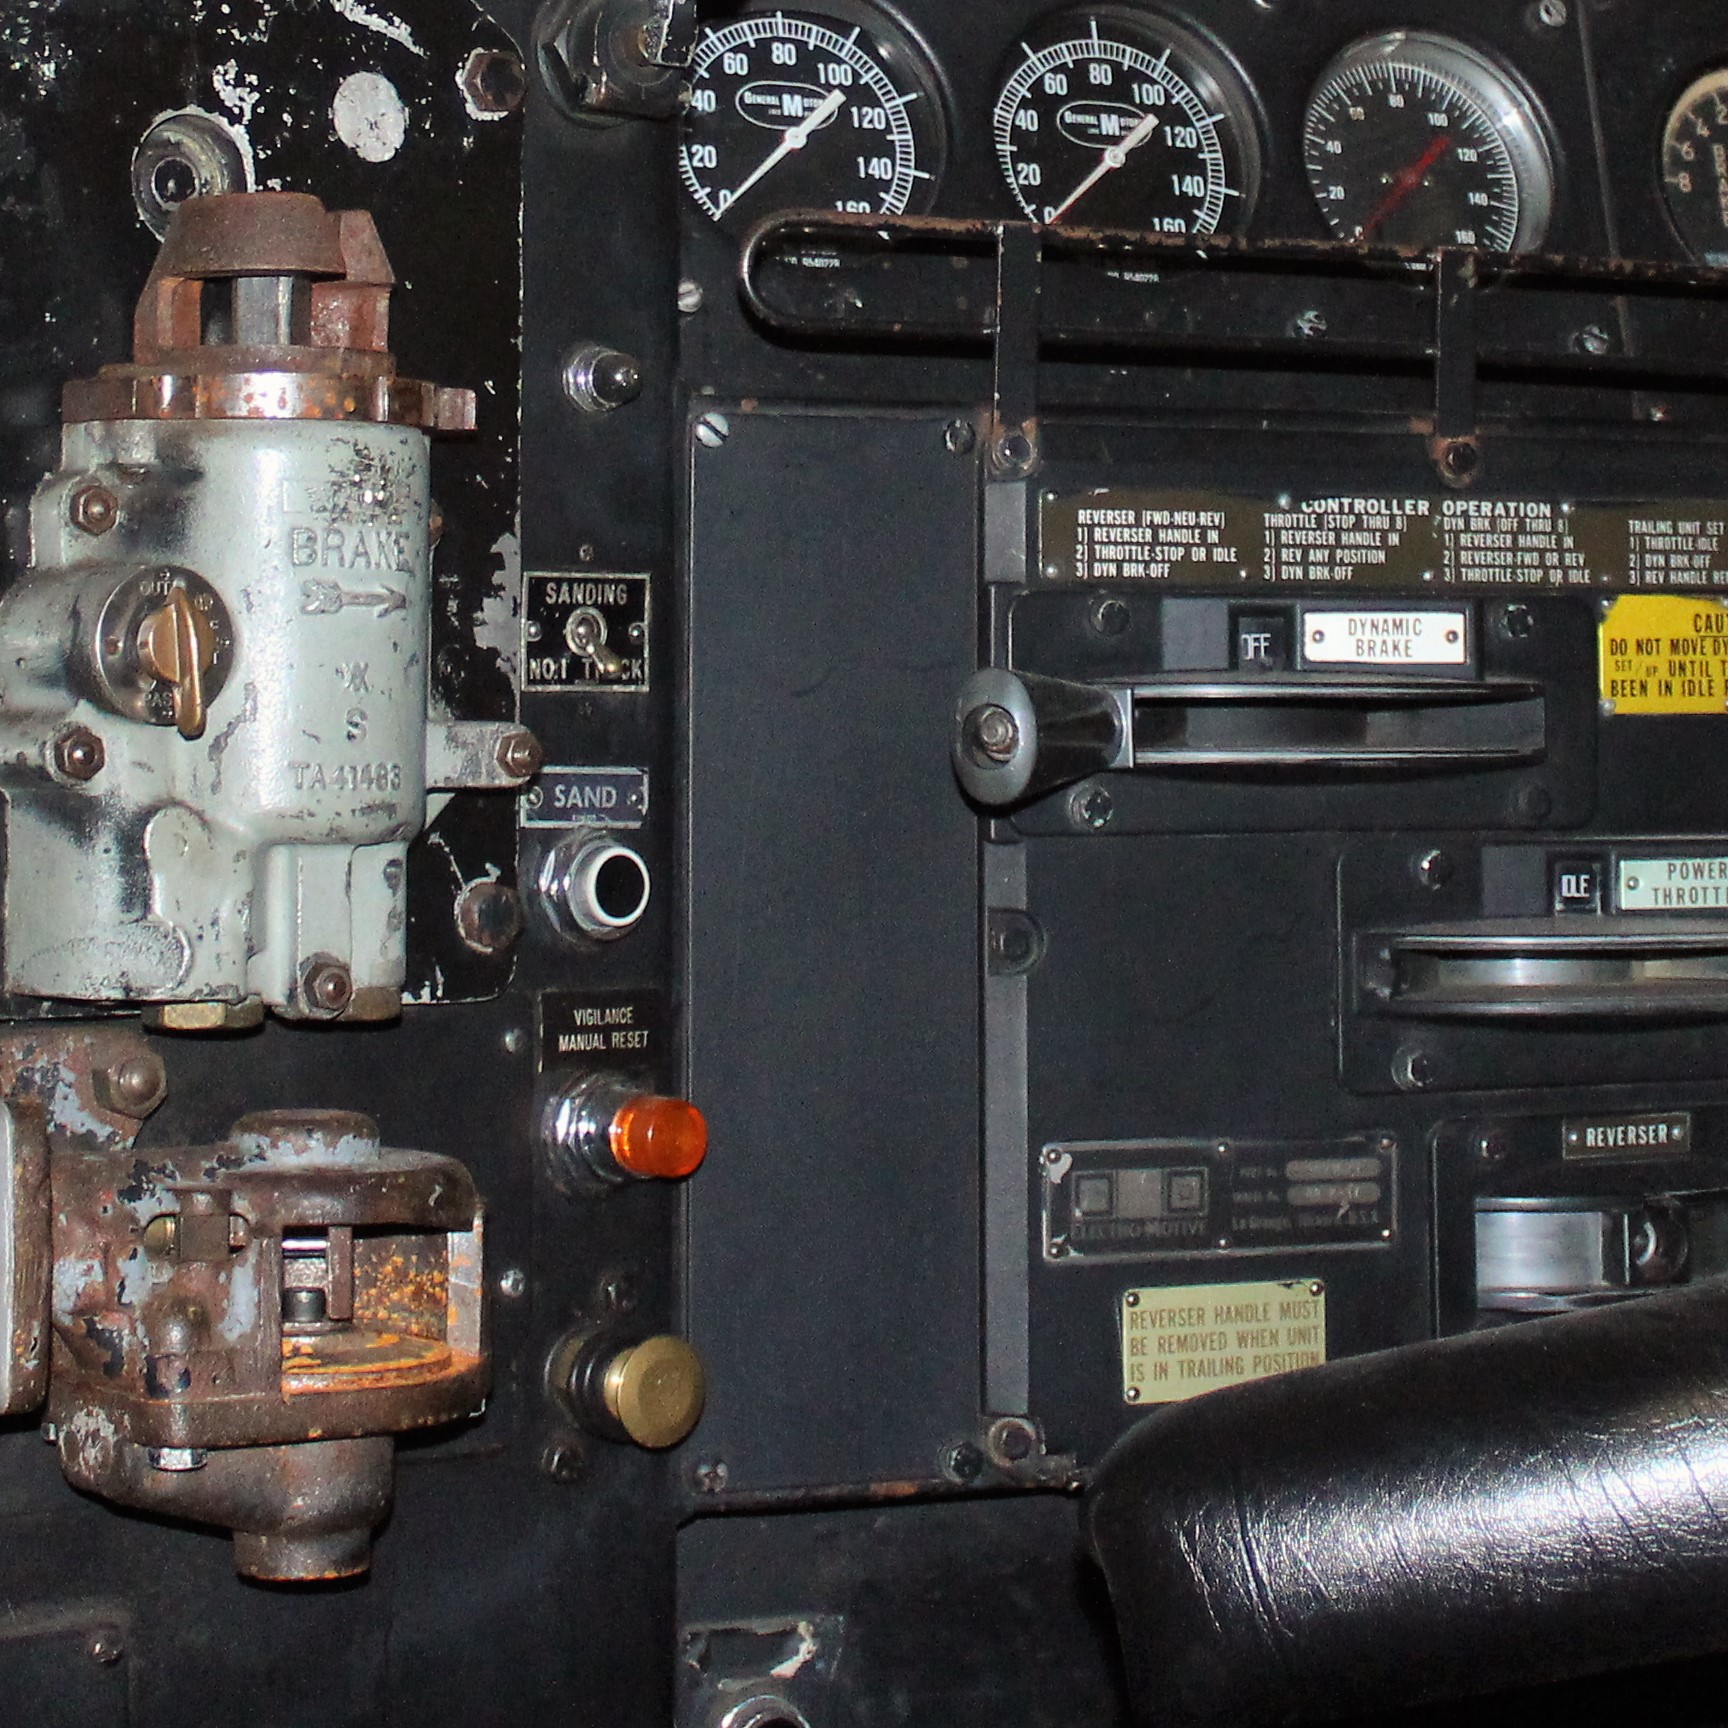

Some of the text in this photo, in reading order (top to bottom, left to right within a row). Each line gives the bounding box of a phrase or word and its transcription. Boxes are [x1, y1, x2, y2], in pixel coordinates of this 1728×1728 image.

[772, 43, 796, 65] 80
[723, 52, 748, 75] 60
[818, 63, 853, 86] 100
[1089, 64, 1112, 85] 80
[1044, 73, 1068, 95] 60
[692, 90, 716, 112] 40
[1132, 83, 1165, 105] 100
[1388, 93, 1404, 108] 80
[850, 106, 886, 130] 120
[1014, 110, 1038, 132] 40
[1428, 113, 1449, 128] 100
[1164, 125, 1198, 148] 120
[692, 145, 717, 168] 20
[1326, 141, 1342, 154] 40
[1458, 149, 1478, 162] 120
[1682, 141, 1695, 161] 6
[857, 156, 892, 180] 140
[1017, 163, 1041, 185] 20
[1172, 174, 1204, 197] 140
[1679, 173, 1692, 193] 8
[1329, 186, 1345, 200] 20
[1468, 193, 1488, 206] 140
[1078, 509, 1135, 524] REVERSER
[1302, 498, 1551, 518] CONTROLLER OPERATION
[1264, 513, 1317, 528] THROTTLE
[1362, 515, 1389, 530] THRU
[1444, 518, 1464, 531] DYN
[1470, 518, 1491, 531] BRK
[1525, 518, 1551, 532] THRU
[1628, 520, 1673, 534] TRAILING
[1678, 521, 1701, 535] UNIT
[1707, 521, 1724, 535] SET
[1094, 528, 1219, 544] REVERSER HANDLE IN
[1281, 531, 1399, 546] REVERSER HANDLE IN
[1460, 534, 1574, 549] REVERSER HANDLE IN
[292, 528, 410, 571] BRAKE
[1191, 547, 1206, 562] OR
[1213, 547, 1237, 562] IDLE
[1281, 548, 1386, 564] REV ANY POSITION
[1545, 552, 1559, 566] OR
[1565, 553, 1585, 566] REV
[1644, 554, 1666, 568] DYN
[1093, 563, 1170, 578] DYN BRK-OFF
[1281, 566, 1303, 580] DYN
[1550, 569, 1563, 583] OR
[1568, 569, 1590, 583] IDLE
[1645, 571, 1665, 584] REV
[1670, 571, 1708, 584] HANDLE
[546, 582, 627, 605] SANDING
[1348, 618, 1423, 636] DYNAMIC
[1242, 634, 1271, 660] OFF
[1356, 640, 1414, 658] BRAKE
[1610, 639, 1627, 656] DO
[1636, 639, 1661, 656] NOT
[1670, 639, 1707, 656] MOVE
[582, 659, 643, 680] TCK
[1669, 660, 1712, 677] UNTIL
[1611, 680, 1647, 697] BEEN
[1659, 680, 1672, 697] IN
[1681, 680, 1715, 697] IDLE
[554, 785, 616, 807] SAND
[1668, 863, 1728, 880] POWER
[574, 1007, 634, 1025] VIGILANCE
[559, 1031, 649, 1052] MANUAL RESET
[1585, 1124, 1668, 1148] REVERSER
[1130, 1300, 1319, 1330] REVERSER HANDLE MUST
[1130, 1326, 1319, 1355] BE REMOVED WHEN UNIT
[1131, 1351, 1320, 1382] IS IN TRAILING POSITION
